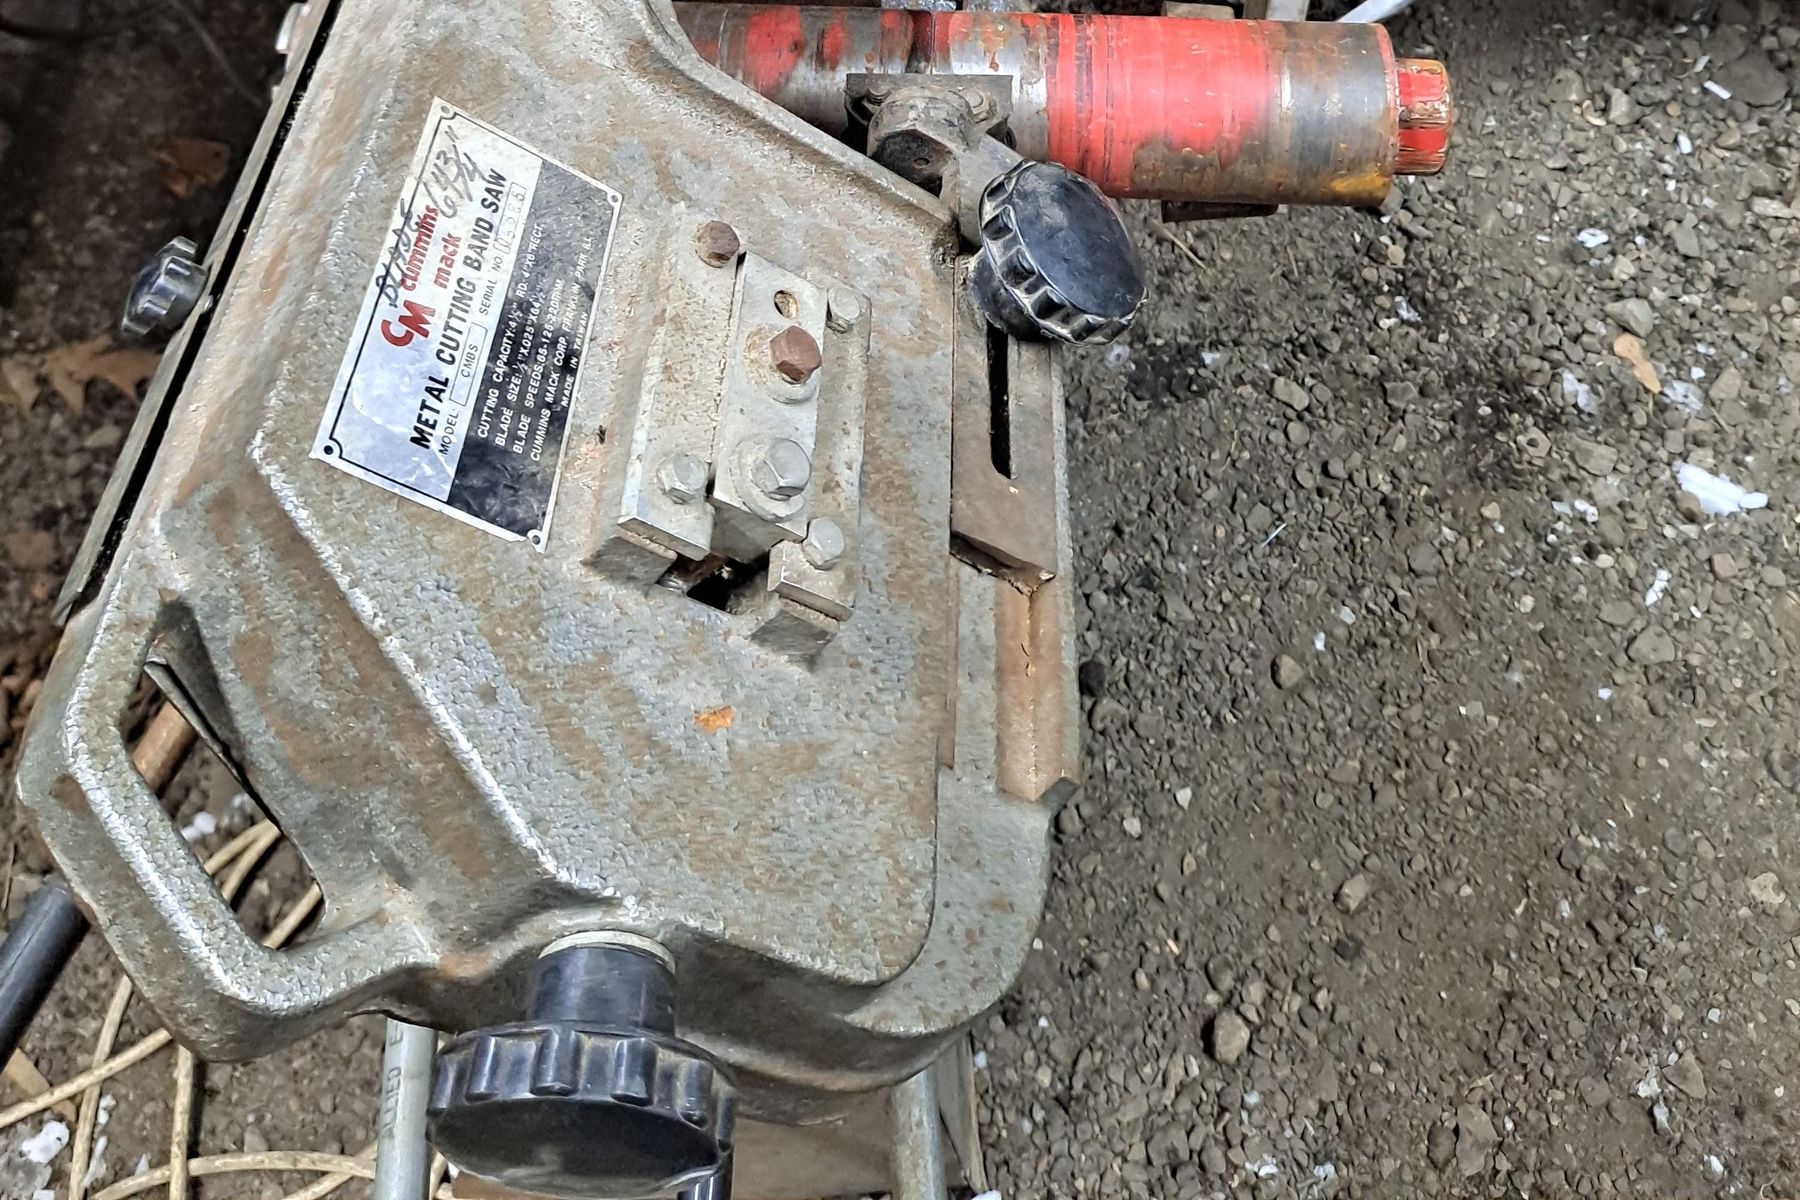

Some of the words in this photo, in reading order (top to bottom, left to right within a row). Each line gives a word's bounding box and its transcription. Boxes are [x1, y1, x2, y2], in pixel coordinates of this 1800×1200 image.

[399, 203, 441, 293] cummins
[433, 231, 462, 290] mack
[409, 375, 450, 450] METAL
[435, 276, 477, 365] CUTTING
[465, 216, 495, 272] BAND
[481, 168, 508, 215] SAW
[459, 342, 479, 379] CMBS
[478, 275, 497, 316] SERIAL
[573, 310, 588, 351] TAIWAN
[559, 372, 575, 408] MADE
[568, 354, 579, 369] IN
[477, 386, 499, 439] CUTTING
[495, 405, 514, 445] BLADE
[506, 371, 523, 402] SIZE:
[513, 413, 531, 453] BLADE
[530, 406, 552, 460] CUMMINS
[544, 369, 560, 404] MACK
